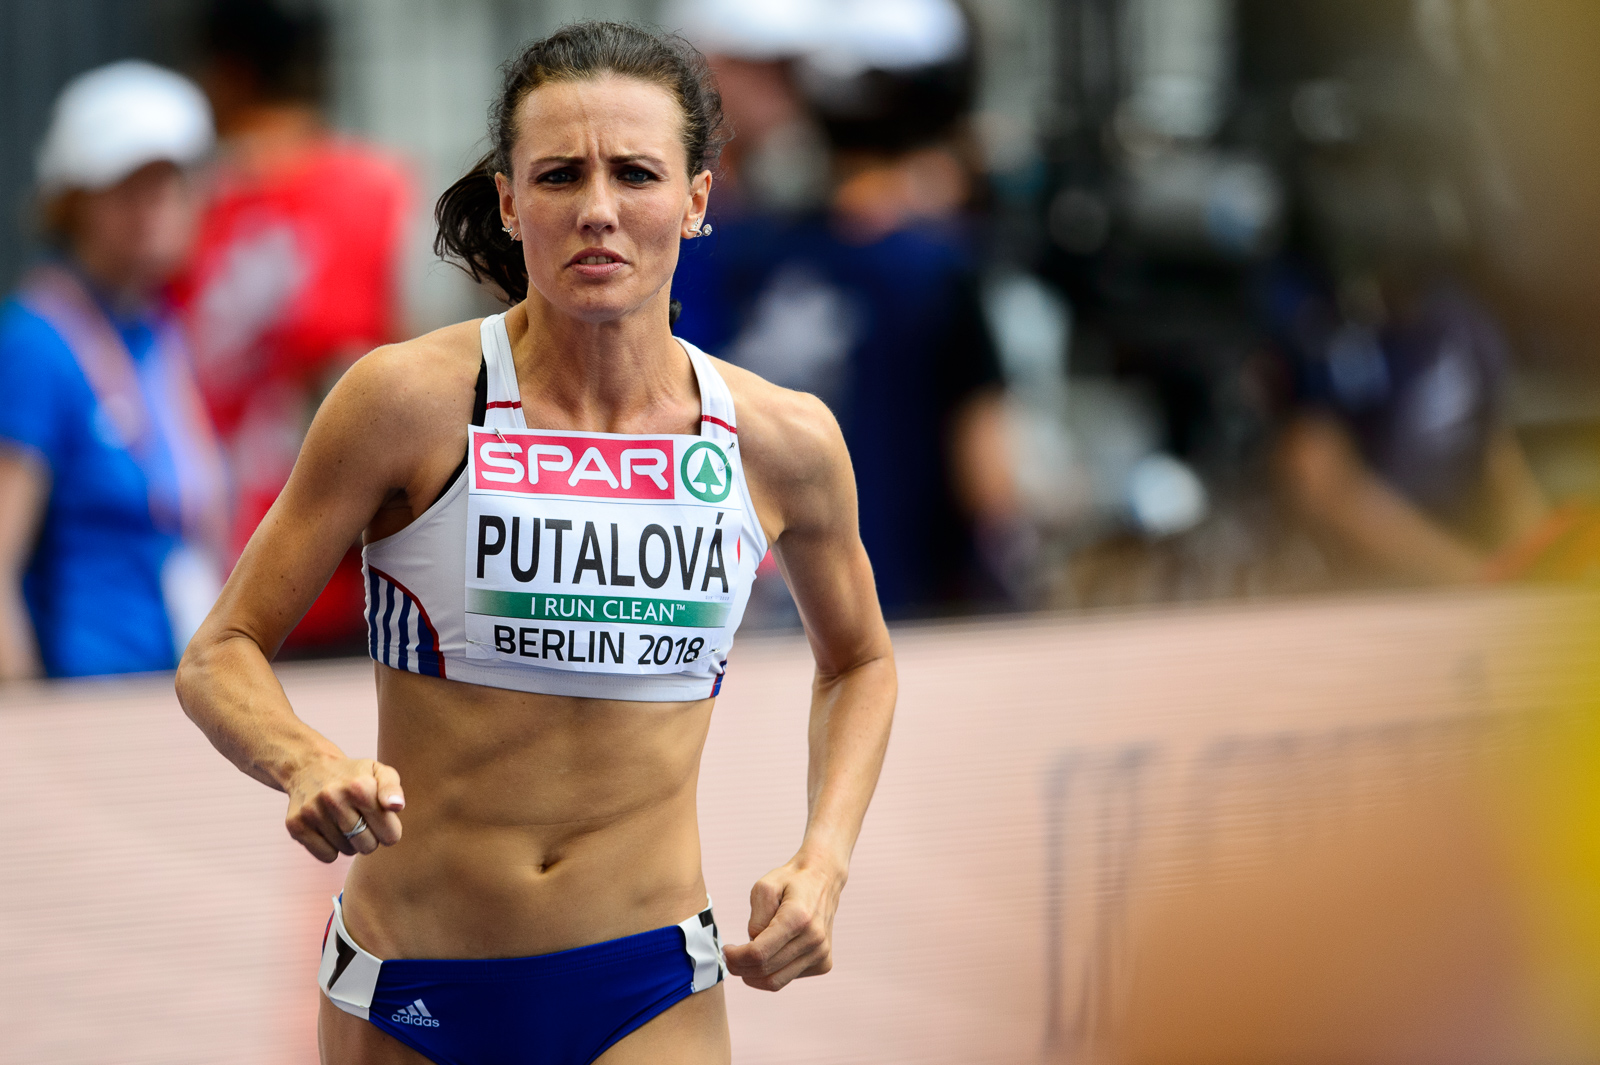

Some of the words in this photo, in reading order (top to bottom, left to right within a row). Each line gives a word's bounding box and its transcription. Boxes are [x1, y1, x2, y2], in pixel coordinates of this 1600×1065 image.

[479, 441, 669, 491] SPAR
[476, 511, 729, 593] PUTALOVÁ
[530, 596, 536, 616] I
[544, 597, 595, 619] RUN
[493, 624, 625, 664] BERLIN
[637, 634, 705, 666] 2018
[391, 1013, 440, 1028] adidas
